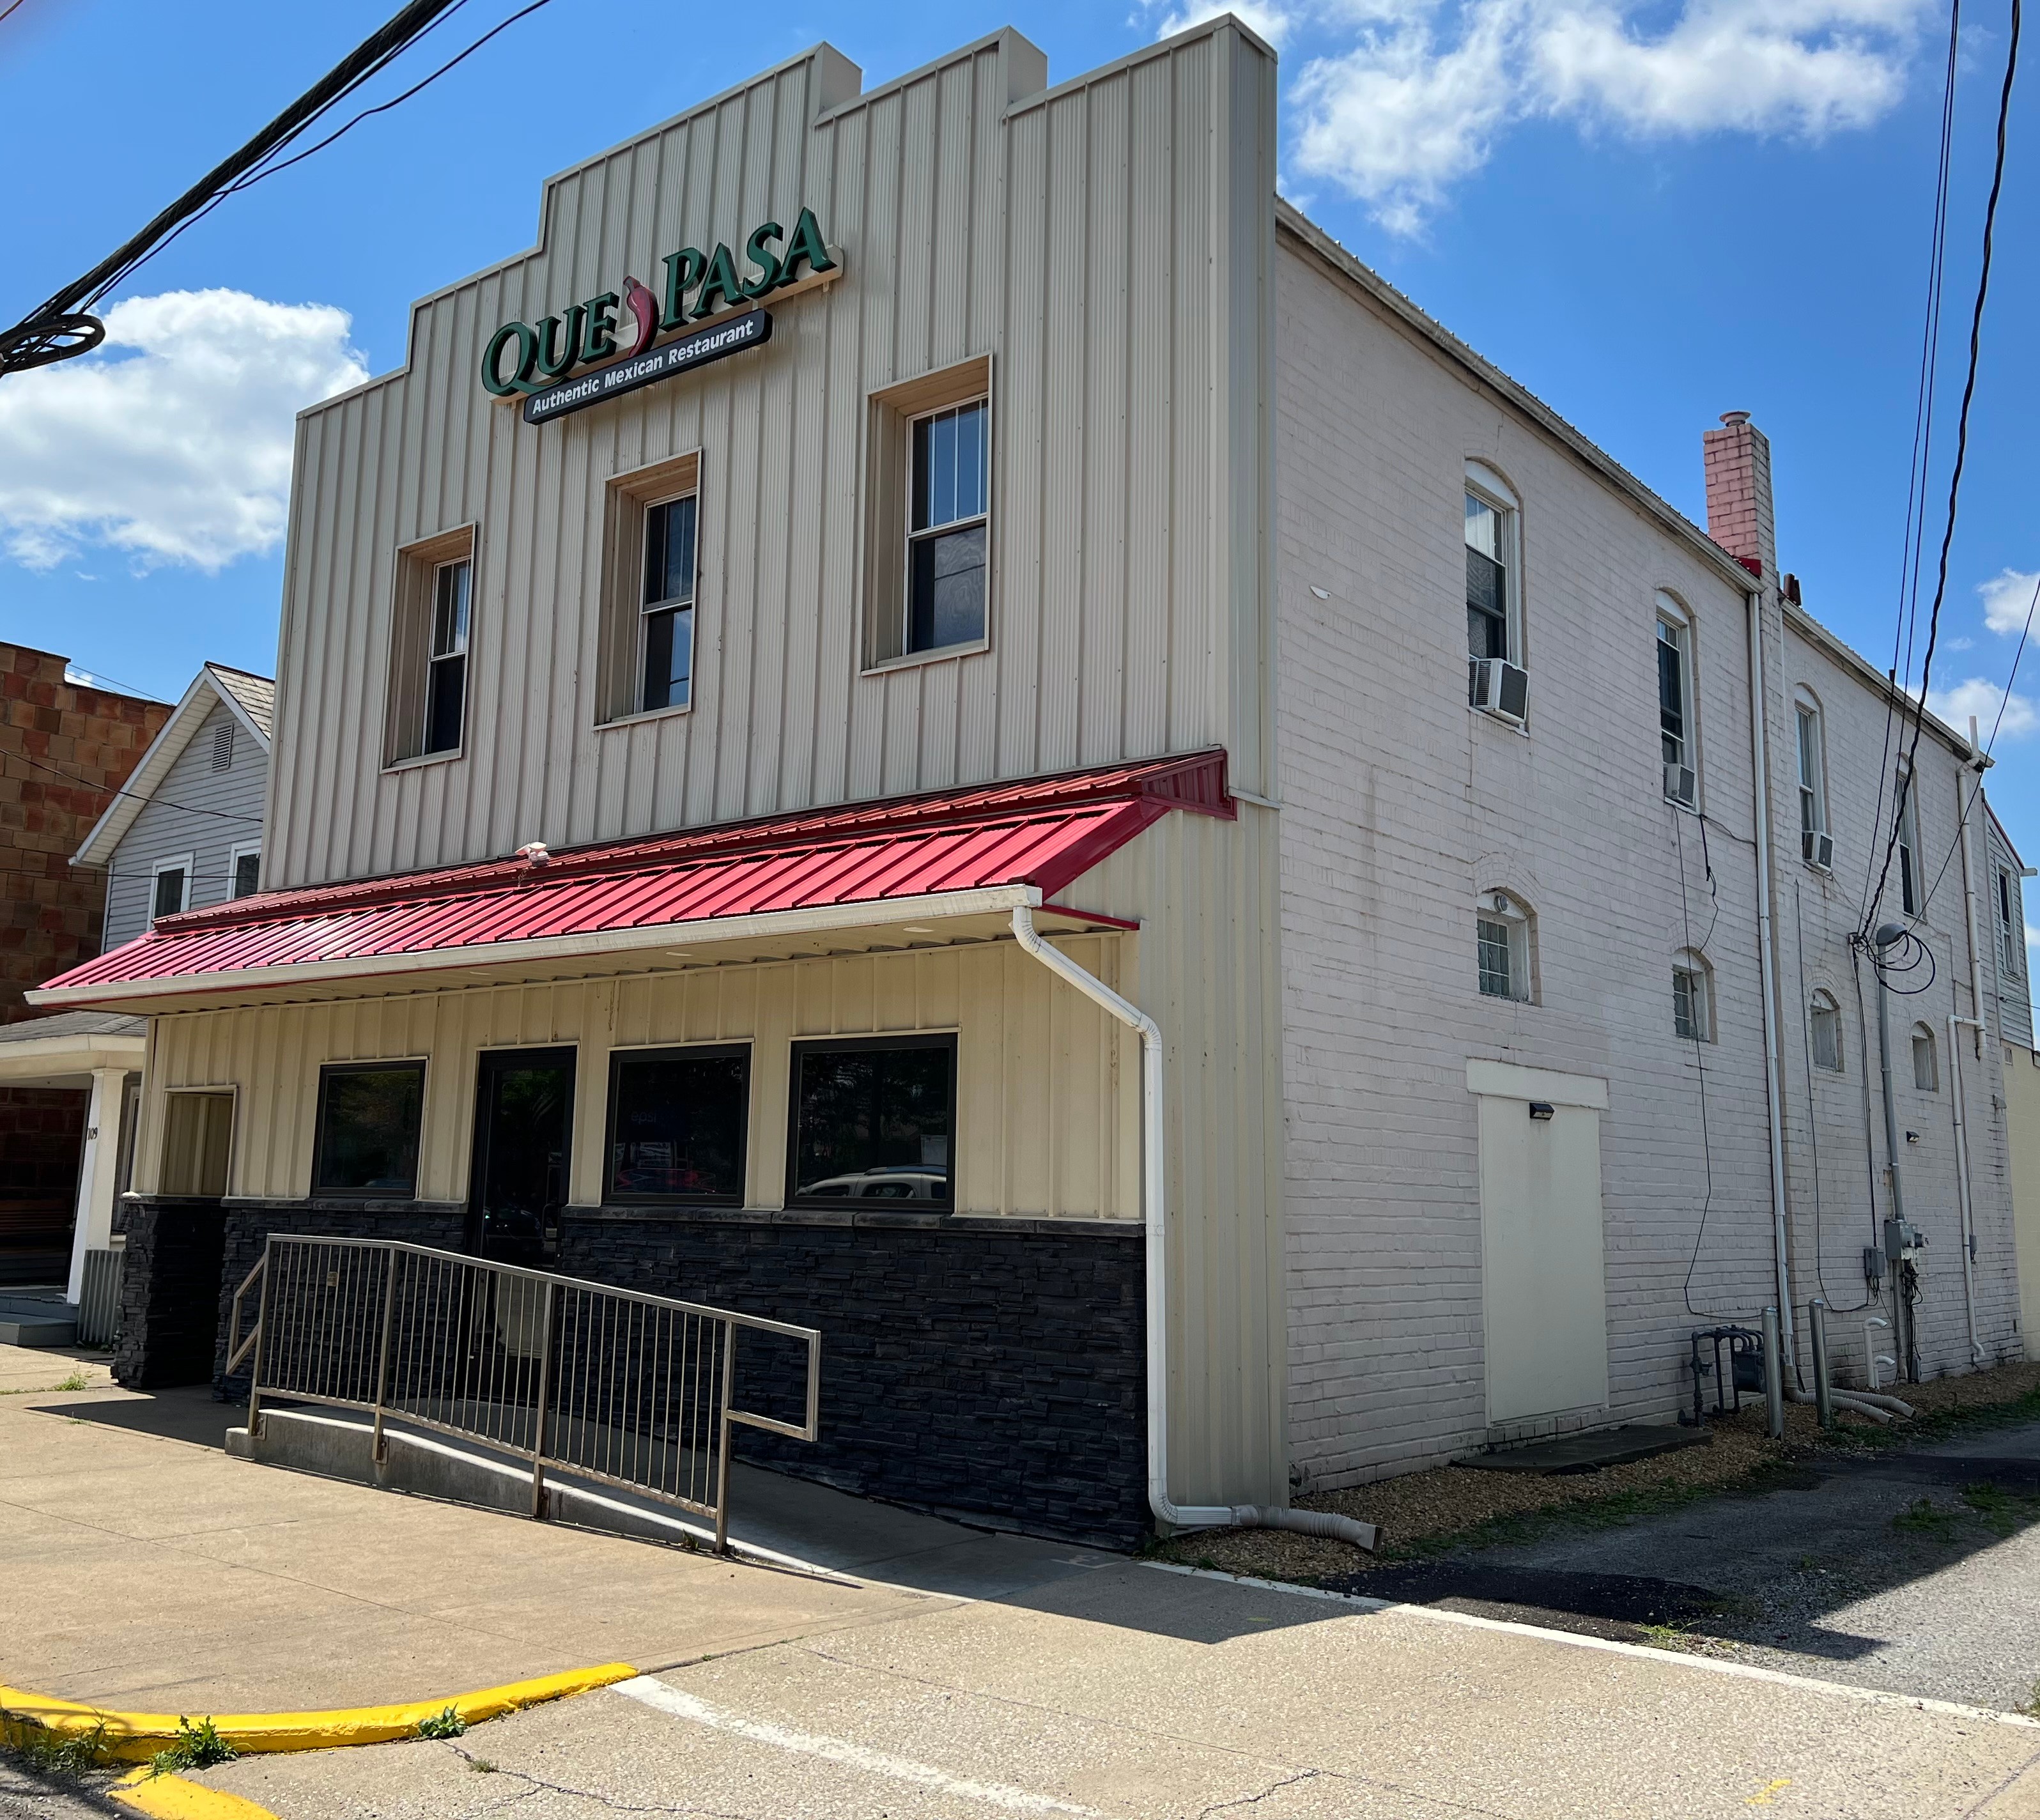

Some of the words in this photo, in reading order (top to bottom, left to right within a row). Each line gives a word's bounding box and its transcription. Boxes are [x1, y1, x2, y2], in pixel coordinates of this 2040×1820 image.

[481, 291, 619, 397] QUE
[658, 206, 837, 332] PASA
[532, 378, 599, 415] Authentic
[604, 355, 663, 389] Mexican
[668, 319, 754, 366] Restaurant
